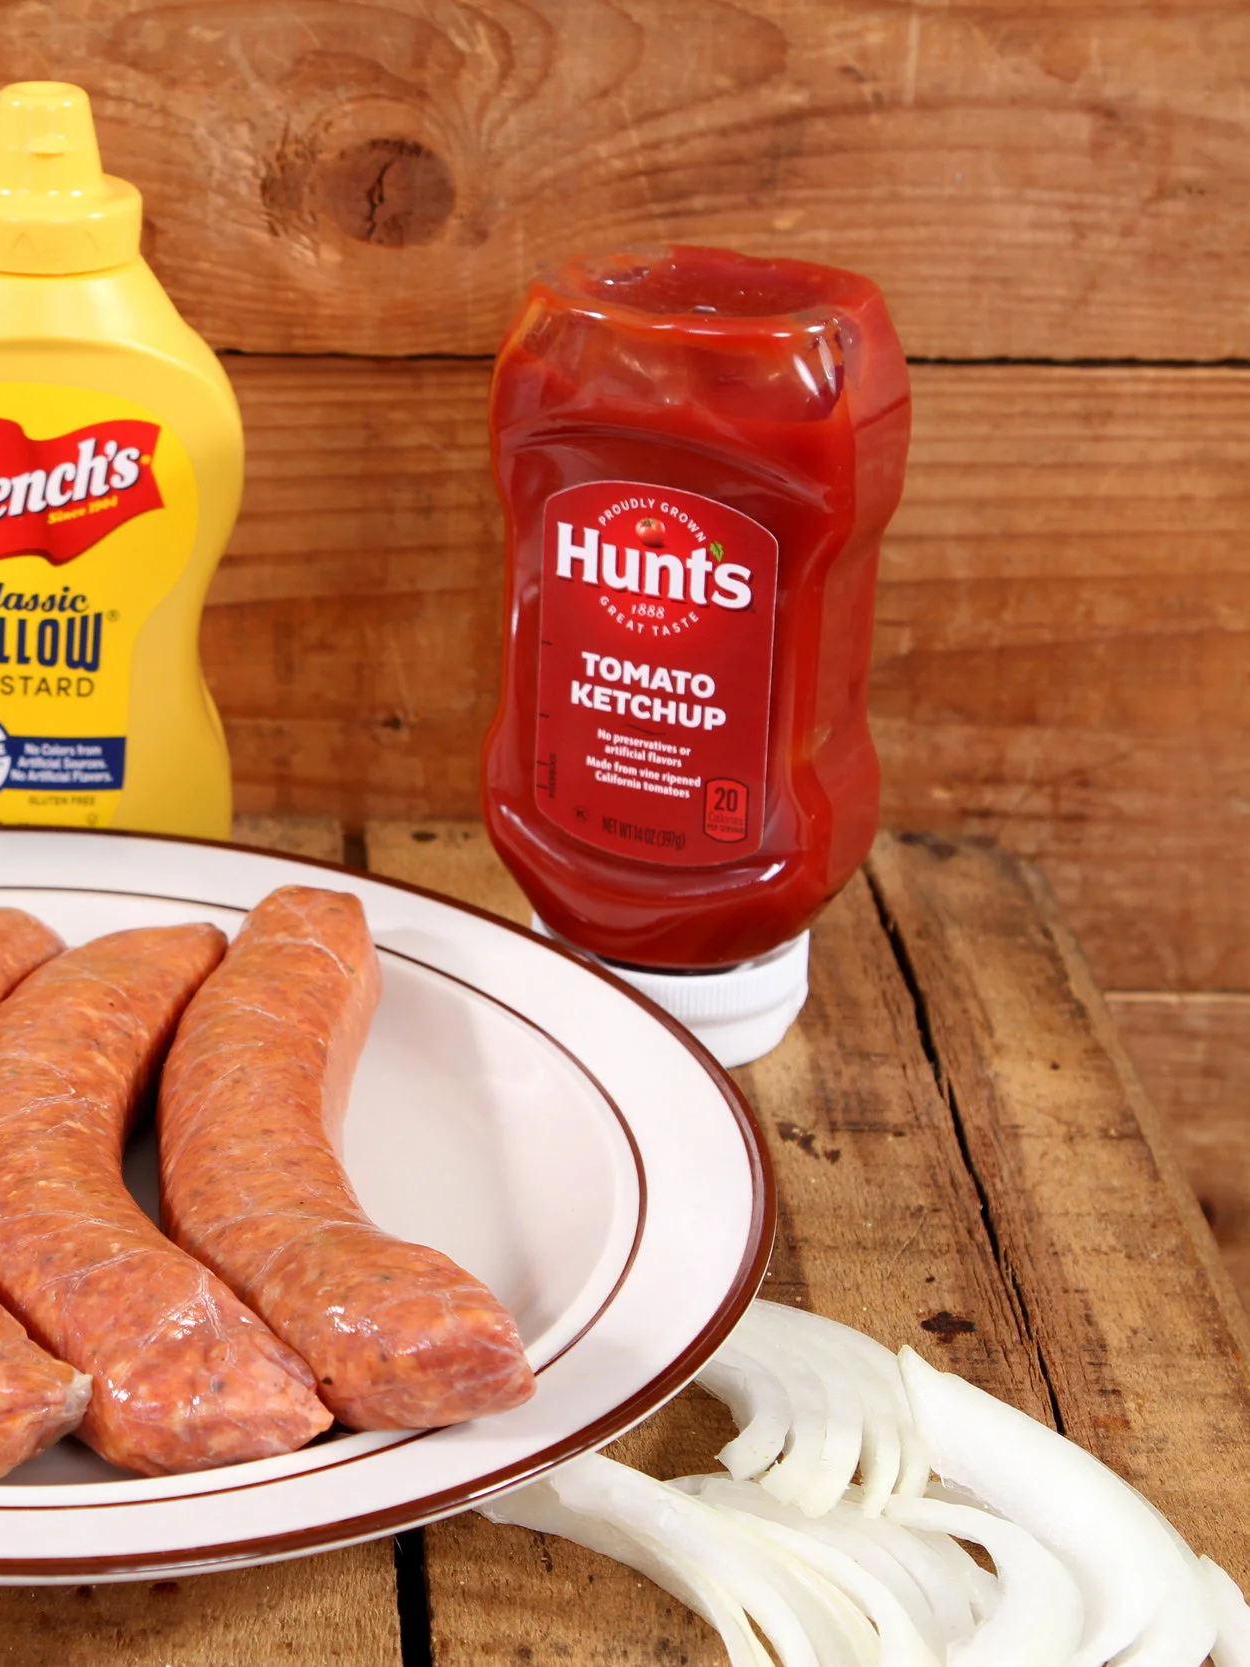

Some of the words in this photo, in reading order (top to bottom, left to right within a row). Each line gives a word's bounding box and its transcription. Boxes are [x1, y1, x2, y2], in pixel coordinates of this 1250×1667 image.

[598, 498, 655, 527] PROUDLY
[660, 502, 707, 543] GROWN
[599, 595, 645, 634] GREAT
[652, 611, 700, 637] TASTE
[631, 602, 665, 620] 1888
[581, 651, 717, 699] TOMATO
[570, 680, 727, 731] KETCHUP
[597, 728, 612, 742] No
[613, 734, 678, 754] preservatives
[679, 747, 691, 757] or
[605, 745, 646, 761] artificial
[648, 751, 682, 768] flavors
[586, 755, 612, 770] Made
[614, 761, 638, 776] from
[640, 768, 660, 780] vine
[662, 772, 701, 788] ripened
[595, 770, 641, 790] California
[643, 781, 690, 799] tomatoes
[714, 787, 738, 813] 20
[602, 815, 618, 836] NET
[620, 821, 633, 840] WT
[645, 826, 657, 846] OZ
